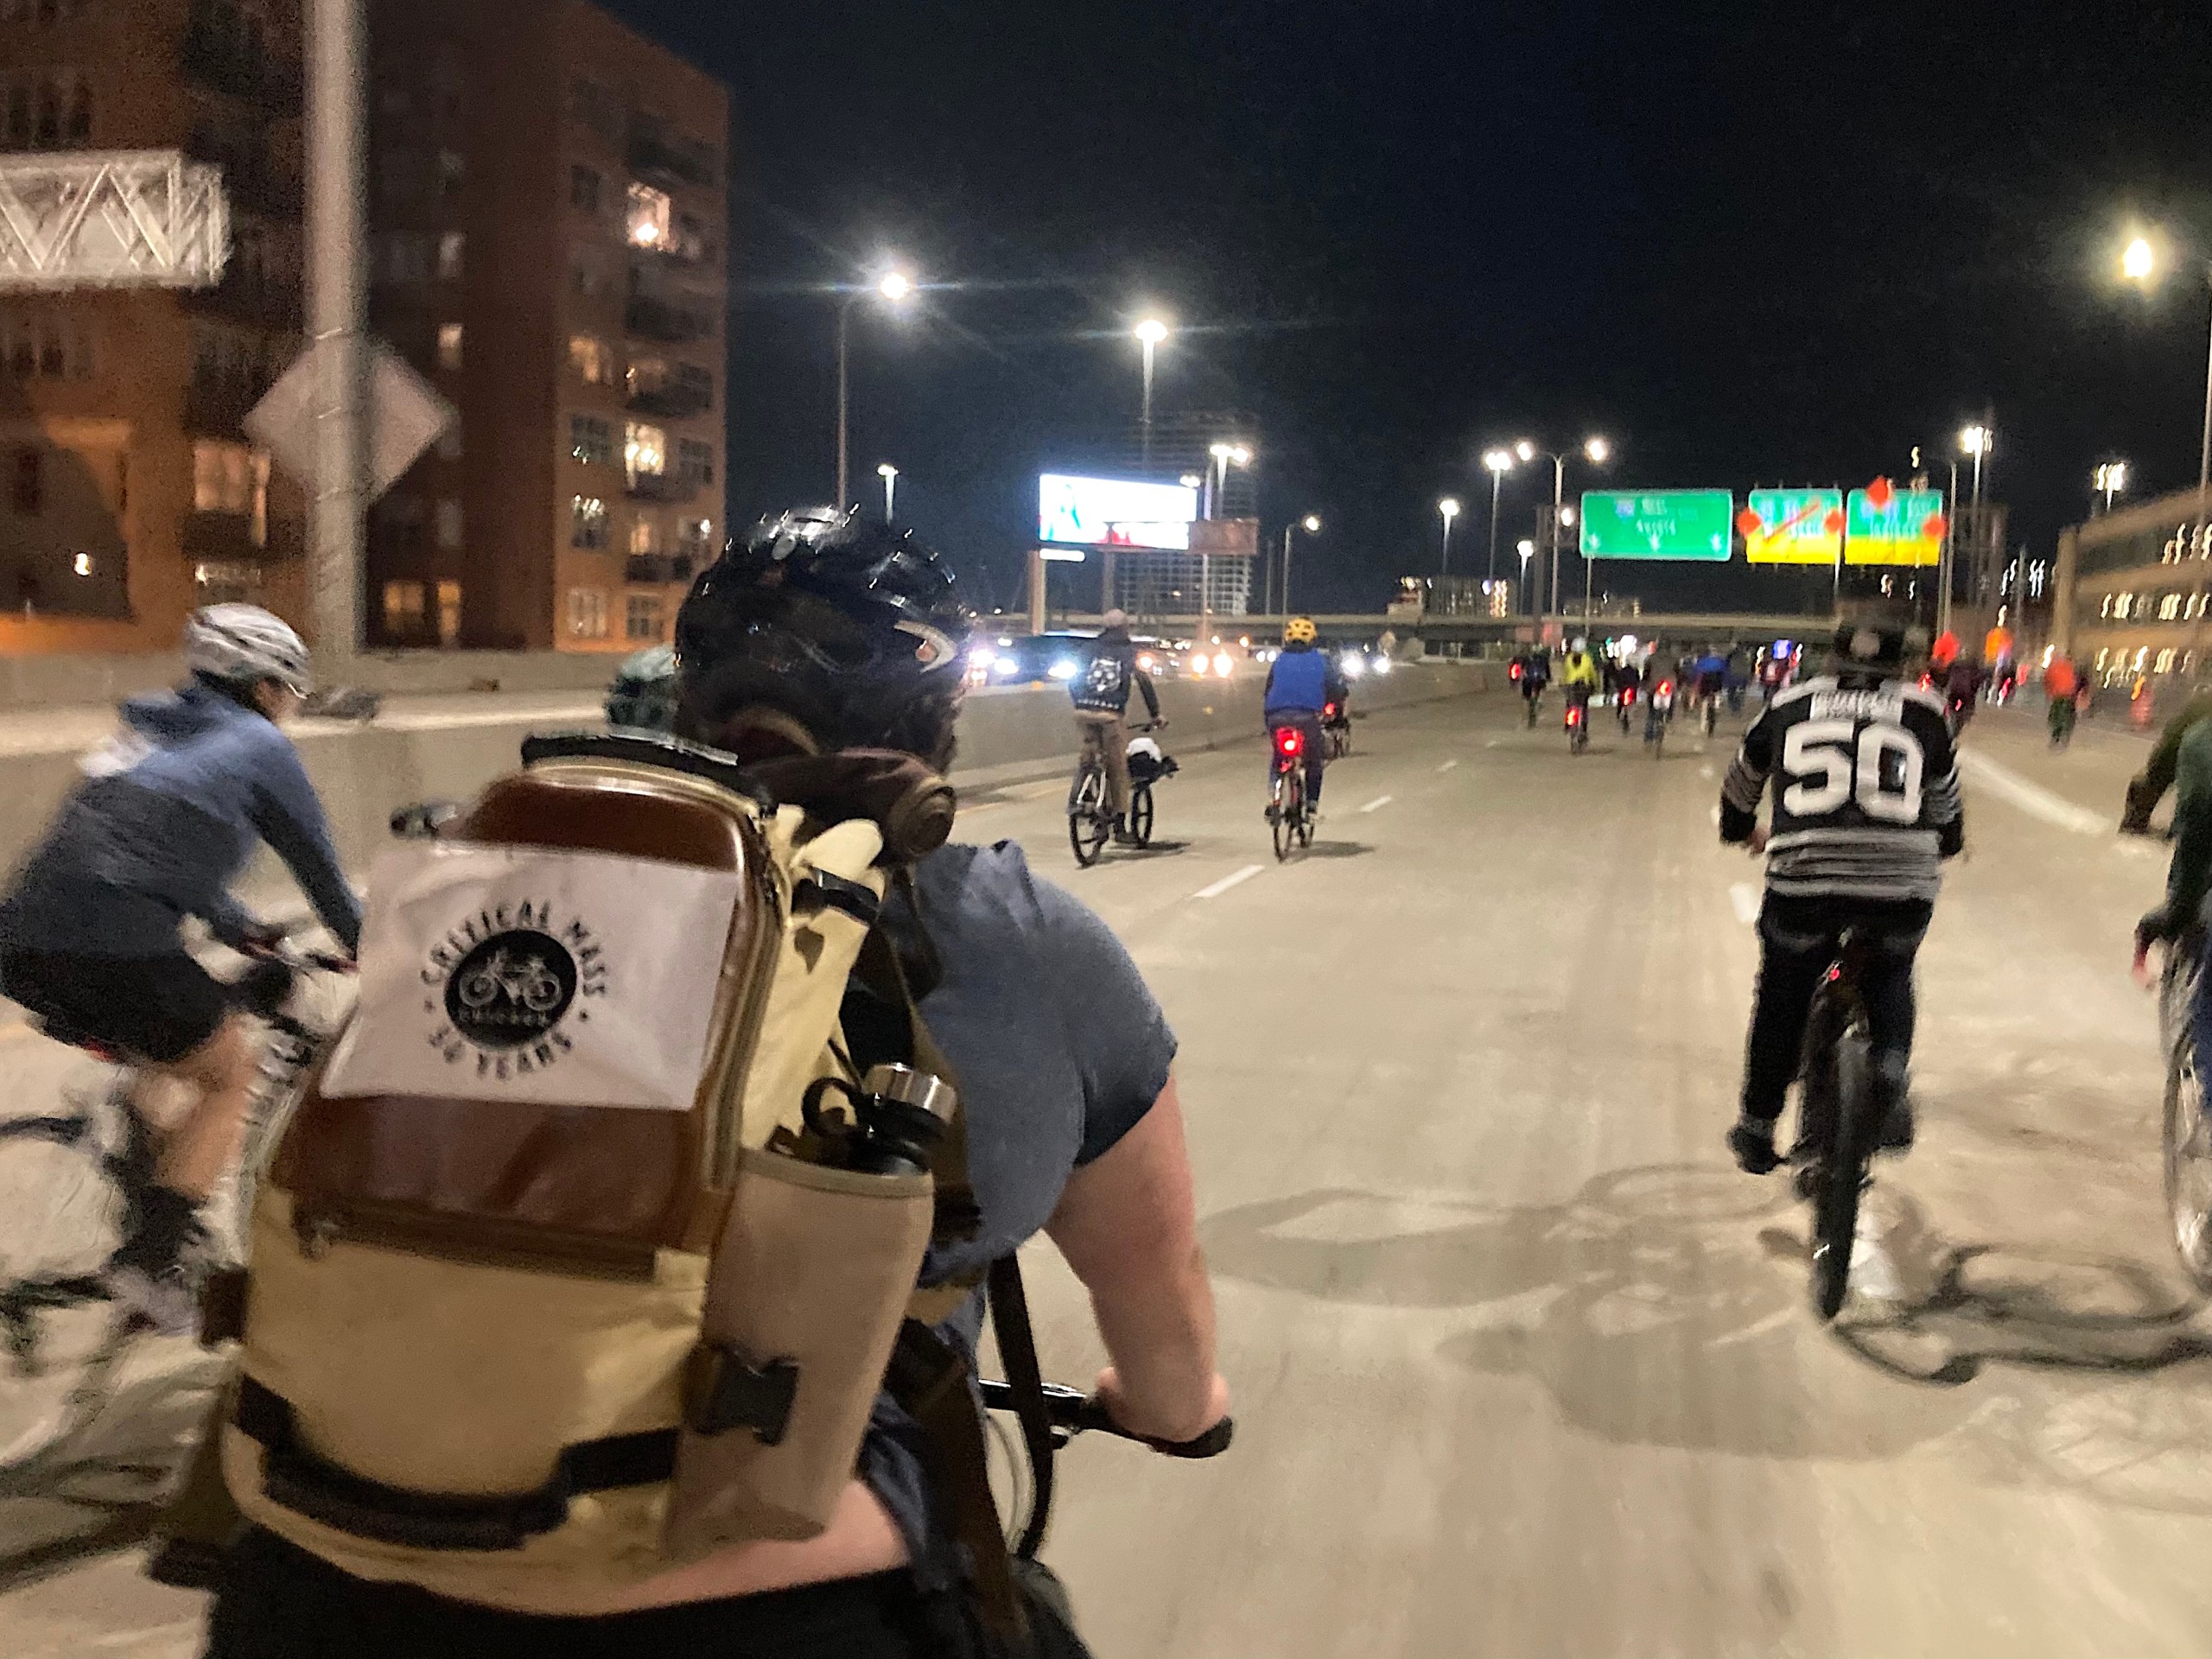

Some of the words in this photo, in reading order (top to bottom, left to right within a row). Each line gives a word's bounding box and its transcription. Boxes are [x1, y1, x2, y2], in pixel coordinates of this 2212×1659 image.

[1783, 721, 1924, 824] 50
[420, 899, 551, 985] CRITICAL
[563, 914, 607, 997] MASS
